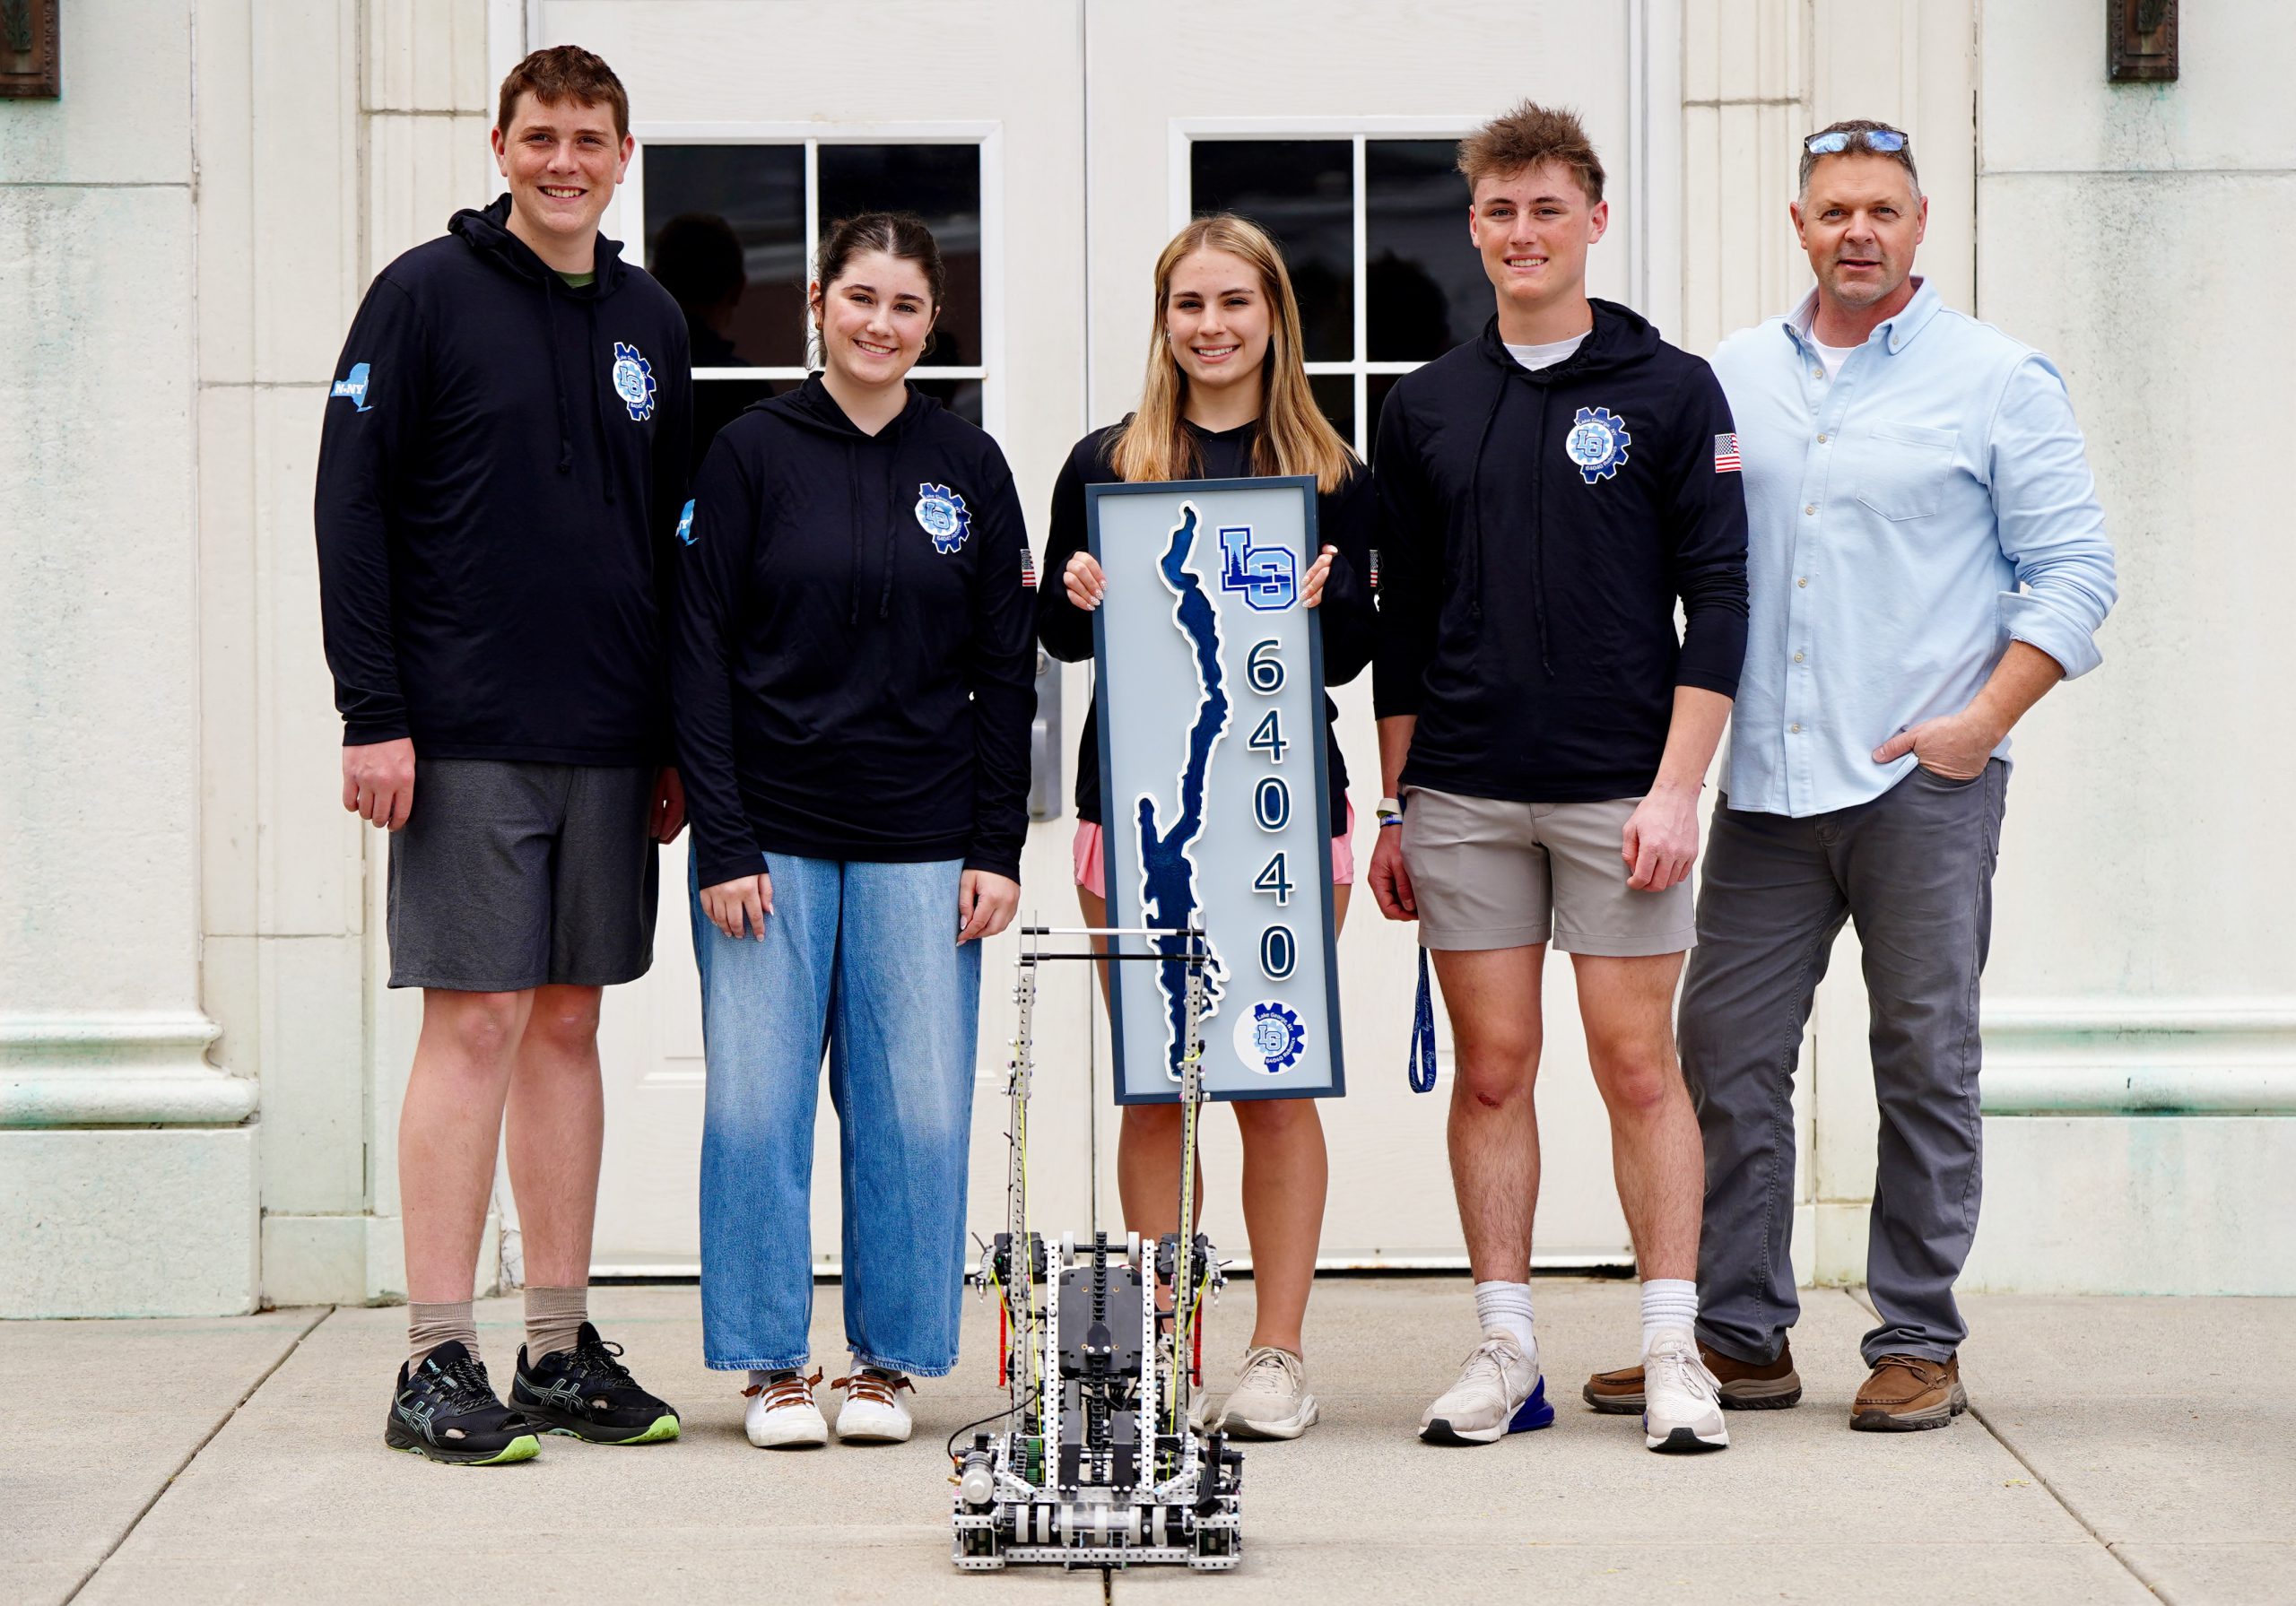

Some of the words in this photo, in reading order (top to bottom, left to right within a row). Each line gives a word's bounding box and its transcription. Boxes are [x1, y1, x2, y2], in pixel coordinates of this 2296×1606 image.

[1257, 1011, 1270, 1020] Lake
[1286, 1023, 1295, 1031] NY
[1265, 1055, 1284, 1063] 64040
[1283, 1037, 1296, 1058] Robotics
